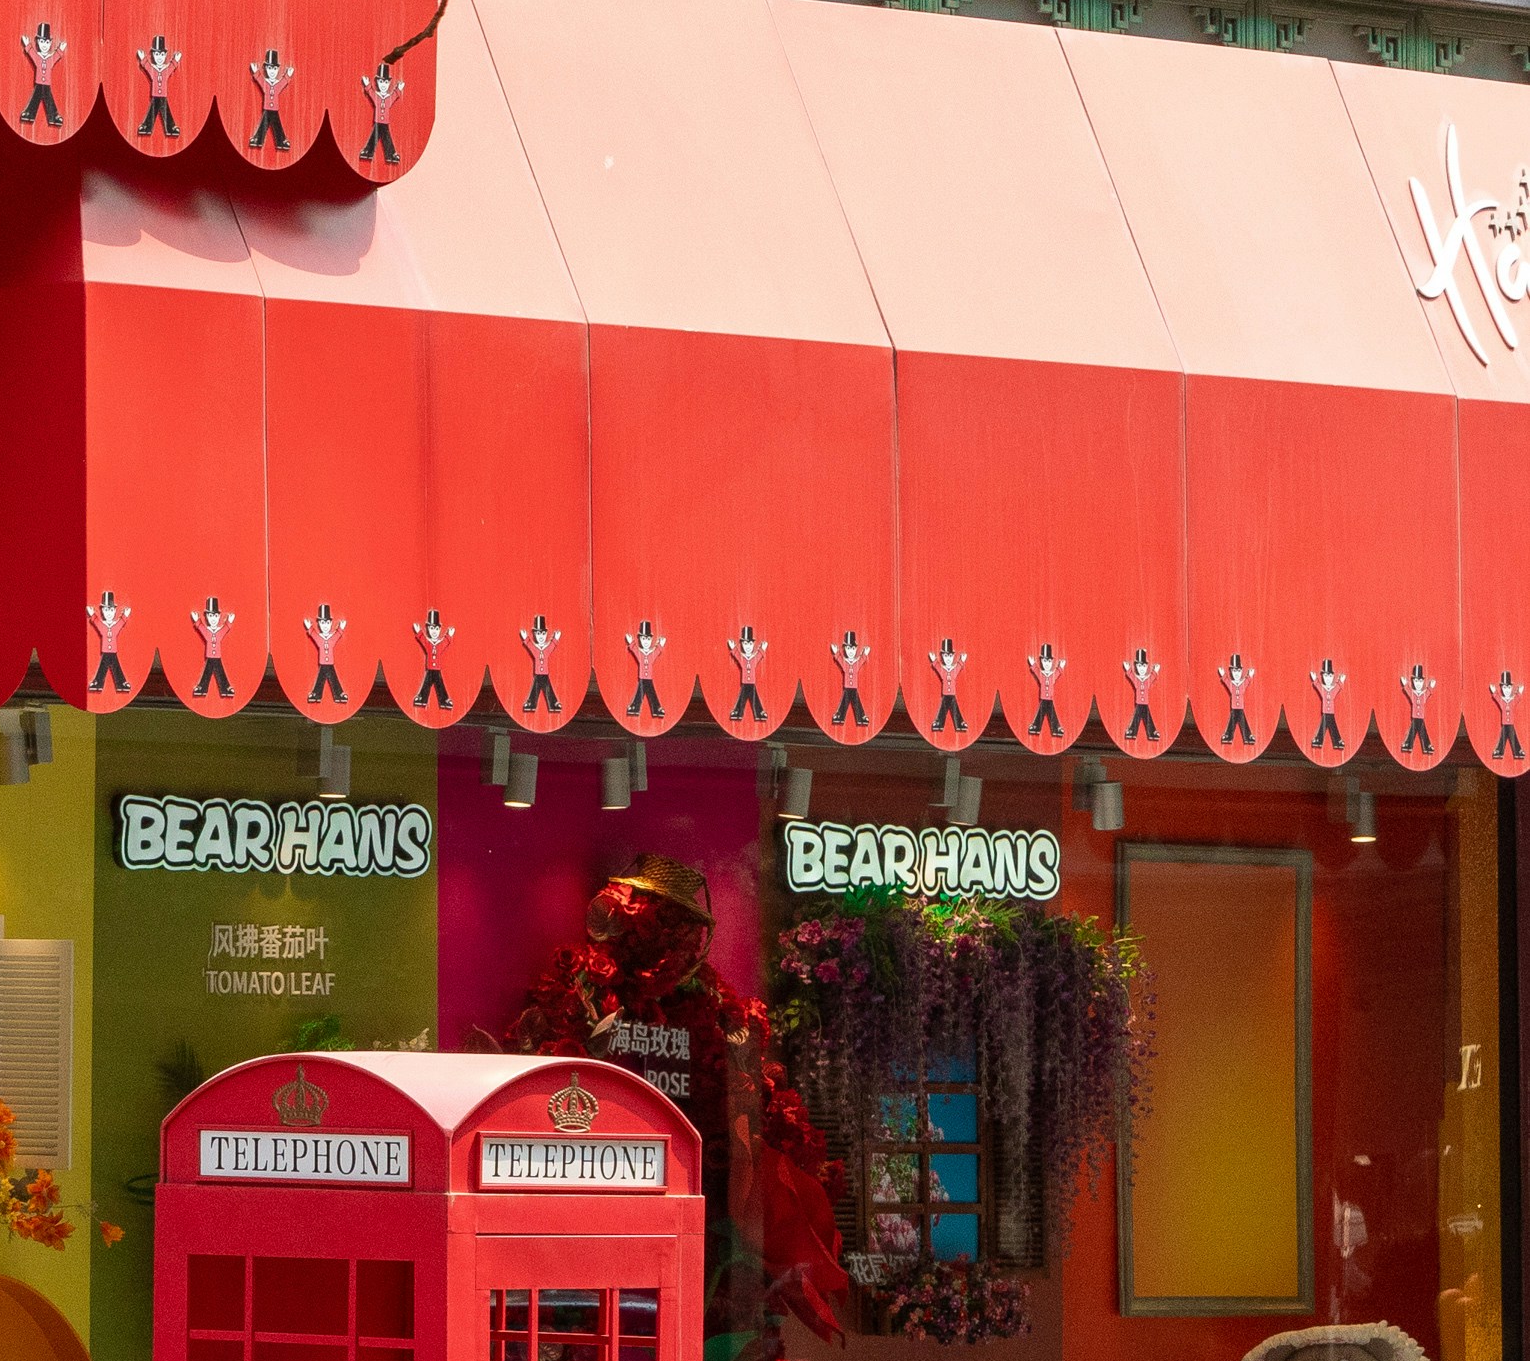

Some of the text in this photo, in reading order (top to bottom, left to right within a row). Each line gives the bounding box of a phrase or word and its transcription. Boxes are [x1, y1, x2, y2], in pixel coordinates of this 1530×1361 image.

[1408, 124, 1530, 367] Ha
[120, 794, 432, 878] BEAR HANS
[785, 823, 1060, 900] BEAR HANS
[212, 924, 329, 960] 风拂番茄叶
[206, 970, 336, 996] TOMATO LEAF
[611, 1021, 691, 1060] 海岛玫瑰
[210, 1137, 402, 1179] TELEPHONE
[487, 1142, 658, 1182] TELEPHONE
